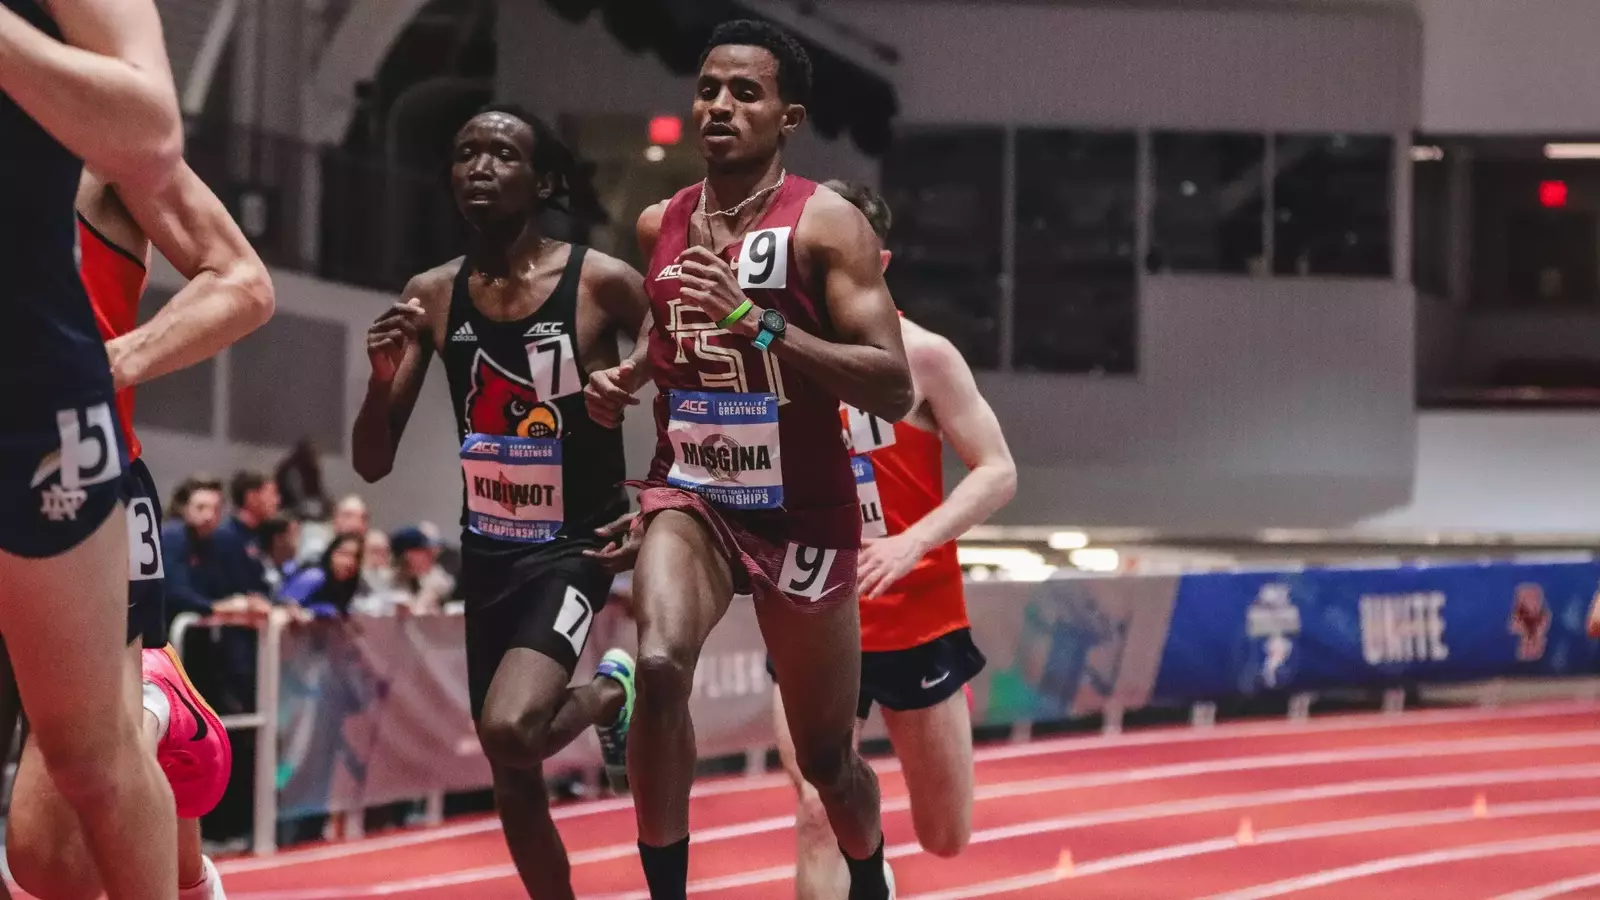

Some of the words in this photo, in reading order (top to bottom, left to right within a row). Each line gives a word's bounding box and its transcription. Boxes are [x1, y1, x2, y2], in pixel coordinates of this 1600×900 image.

[747, 230, 776, 284] 9
[523, 322, 564, 337] ACC
[537, 339, 562, 395] 7
[677, 399, 709, 415] ACC
[718, 406, 767, 416] GREATNESS
[467, 441, 501, 455] ACC
[680, 442, 772, 472] MISGINA
[474, 476, 555, 507] KIBIWOT
[134, 502, 158, 575] 3
[477, 520, 551, 539] CHAMPIONSHIPS
[788, 545, 825, 591] 9
[566, 593, 590, 638] 7
